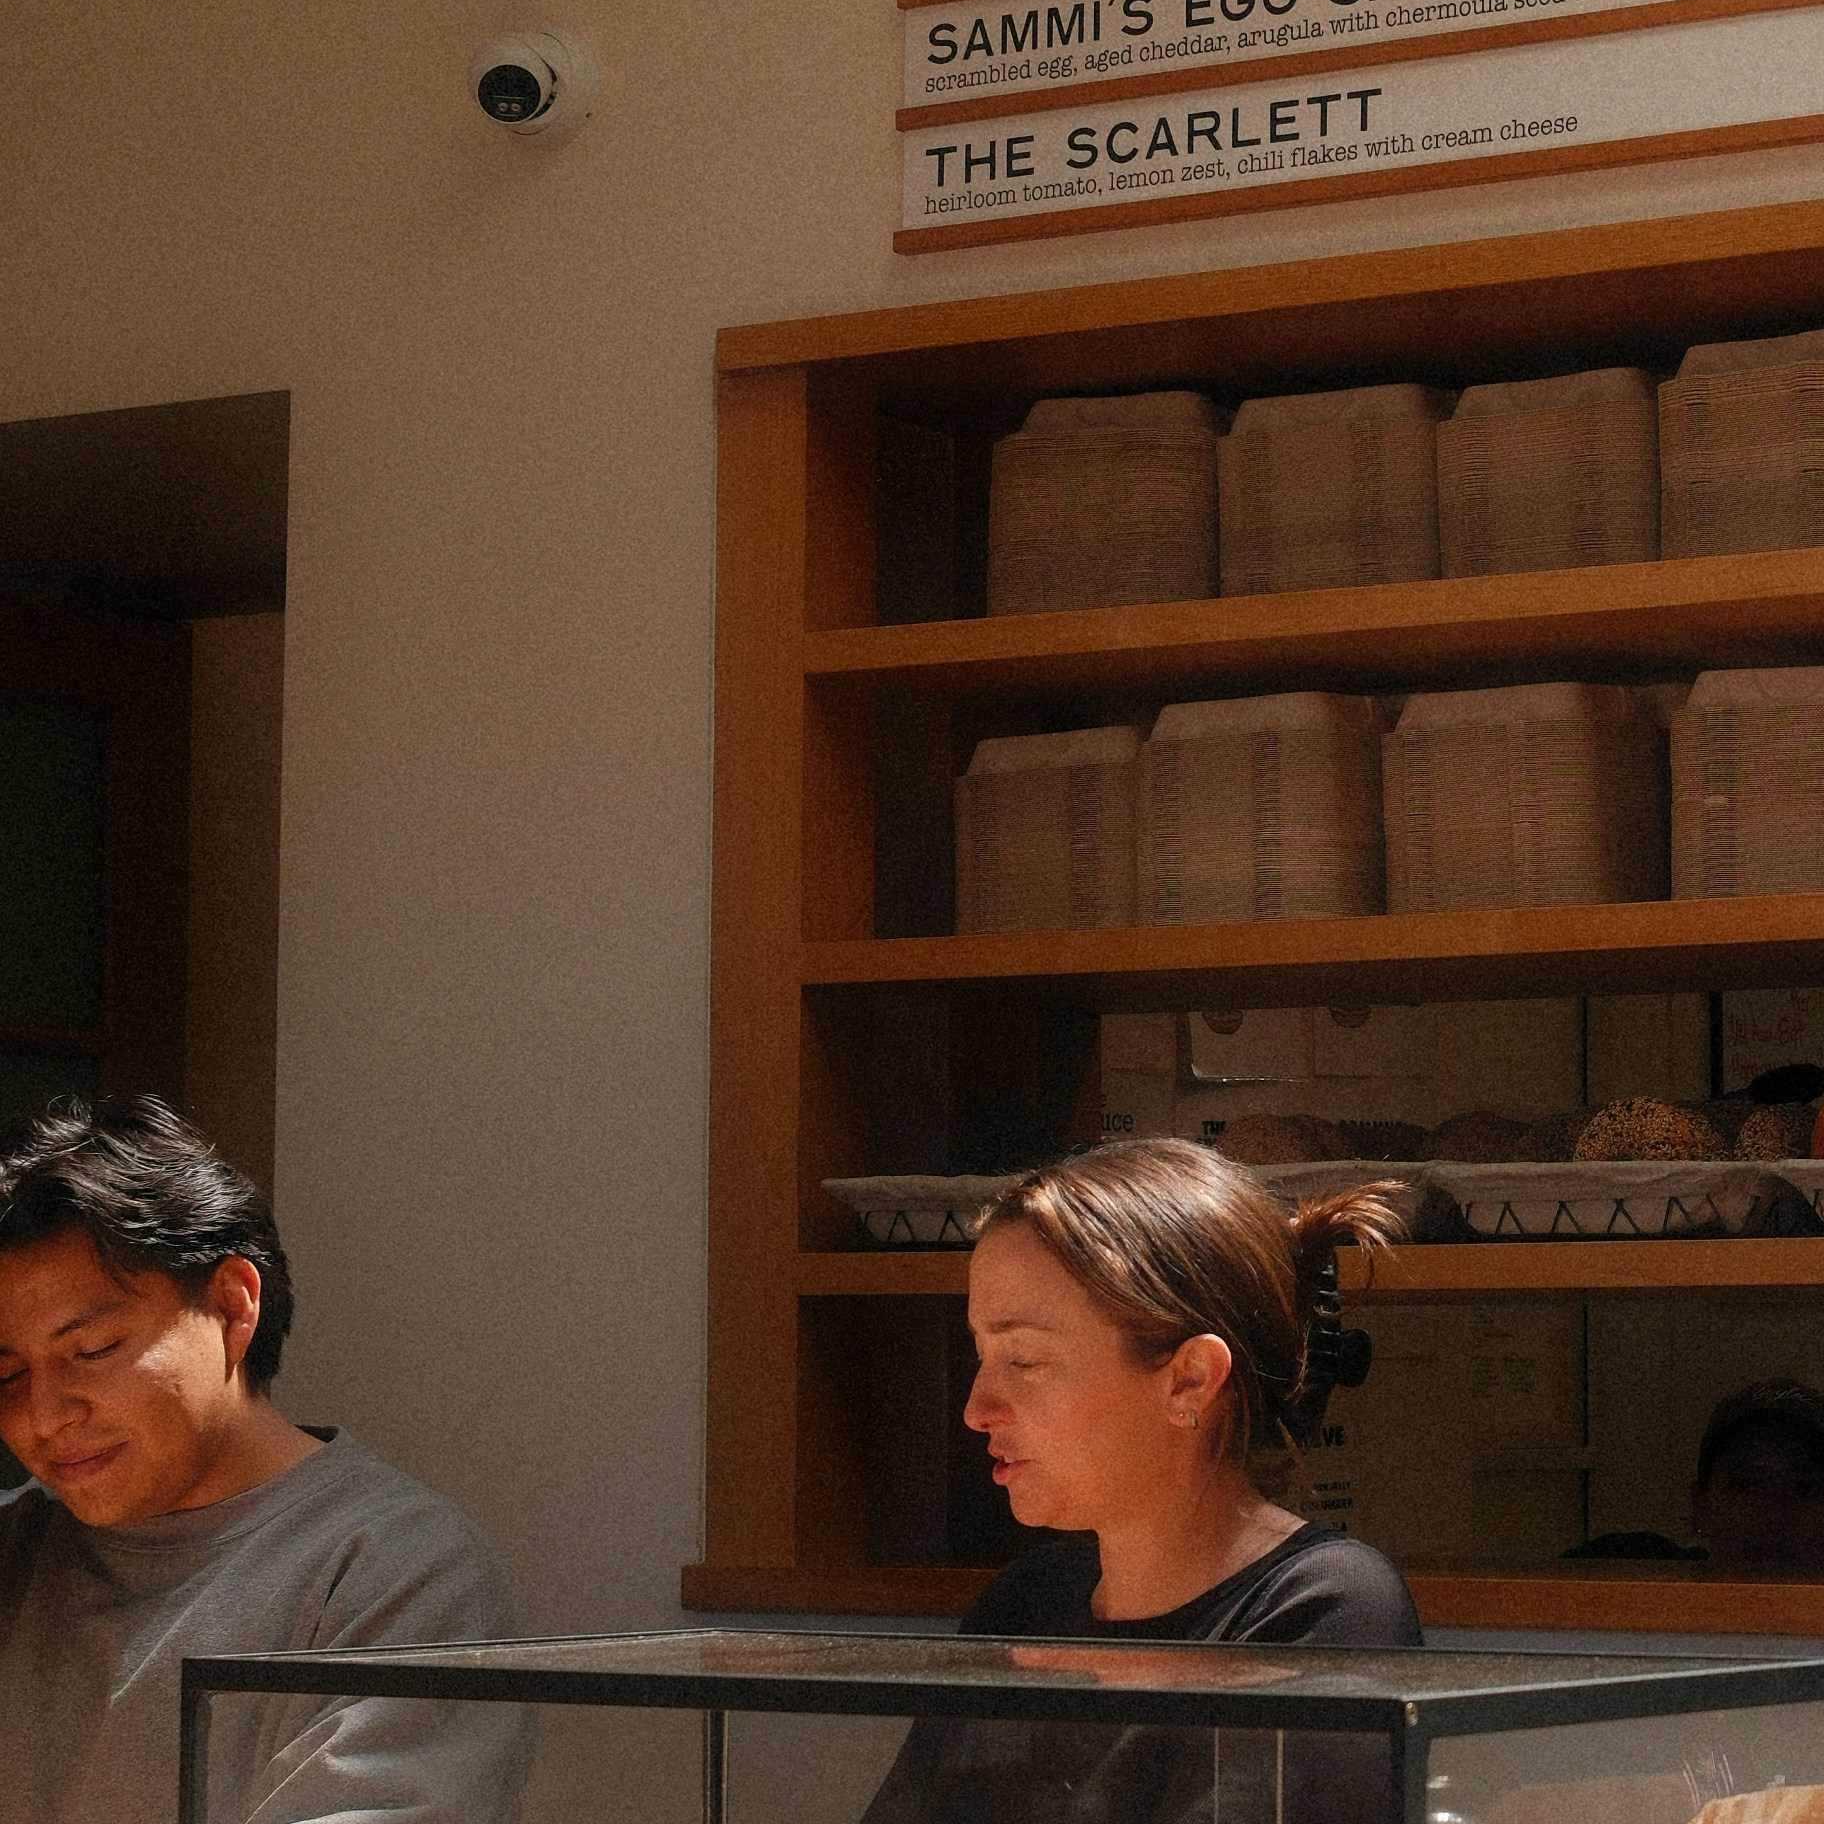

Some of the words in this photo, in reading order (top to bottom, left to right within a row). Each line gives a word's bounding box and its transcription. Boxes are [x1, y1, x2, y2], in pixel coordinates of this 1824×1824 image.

[926, 60, 1031, 92] scrambled
[1038, 55, 1077, 79] egg,
[1085, 45, 1132, 72] aged
[1140, 35, 1230, 62] cheddar,
[1238, 19, 1323, 48] arugula
[1329, 11, 1378, 34] with
[925, 135, 1034, 187] THE
[1066, 88, 1382, 169] SCARLETT
